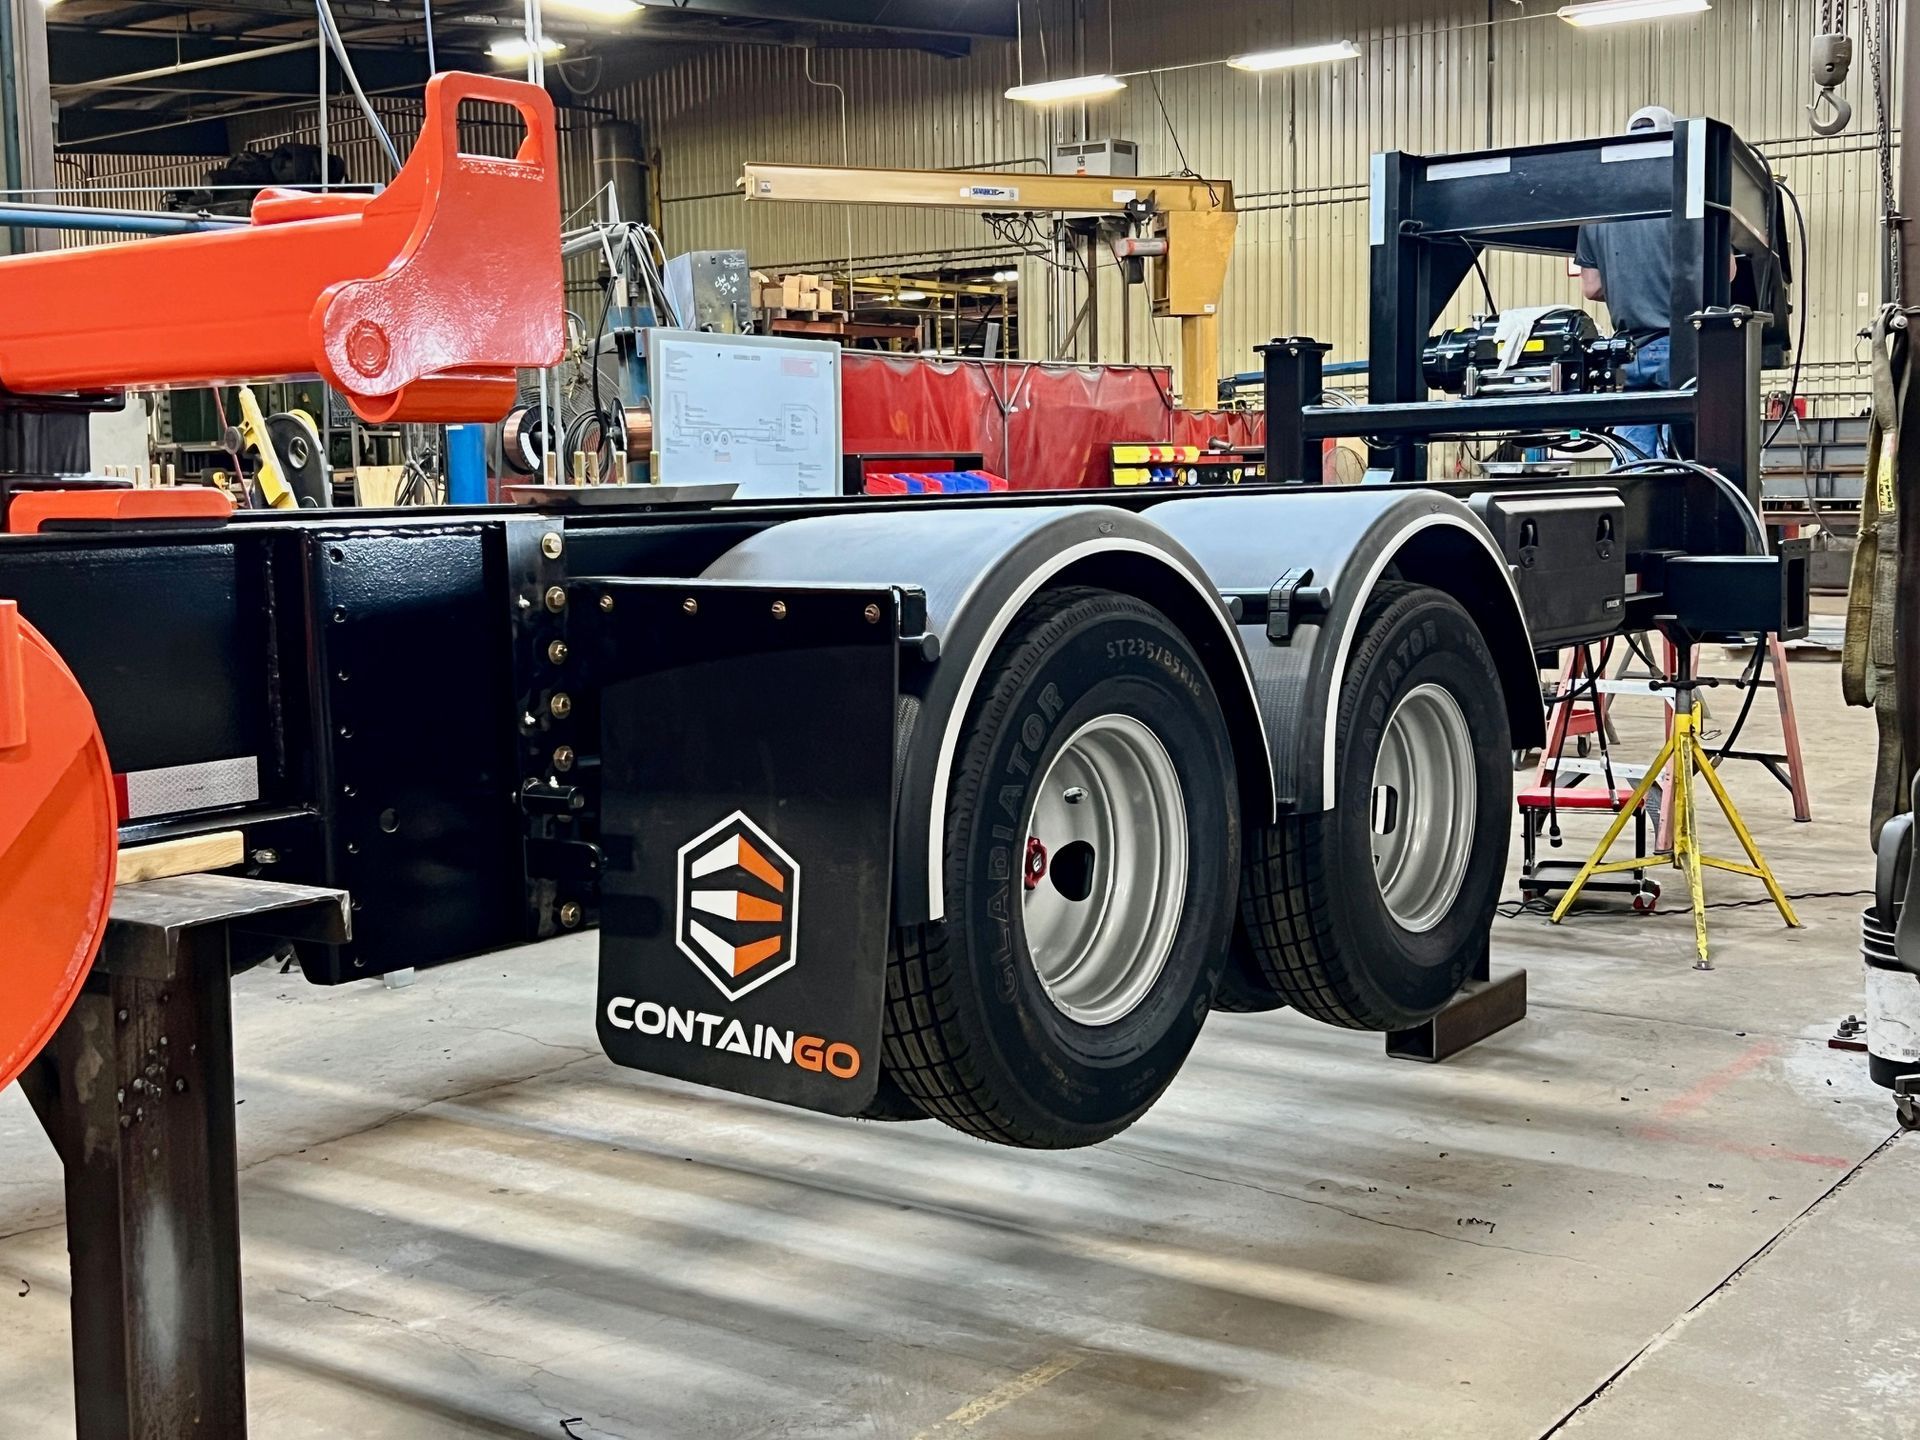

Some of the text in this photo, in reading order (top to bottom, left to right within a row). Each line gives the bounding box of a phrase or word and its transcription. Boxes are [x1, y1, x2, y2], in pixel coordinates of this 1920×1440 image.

[1106, 637, 1201, 697] ST235/85R16
[987, 682, 1064, 1001] GLADIATOR
[607, 996, 860, 1079] CONTAINGO
